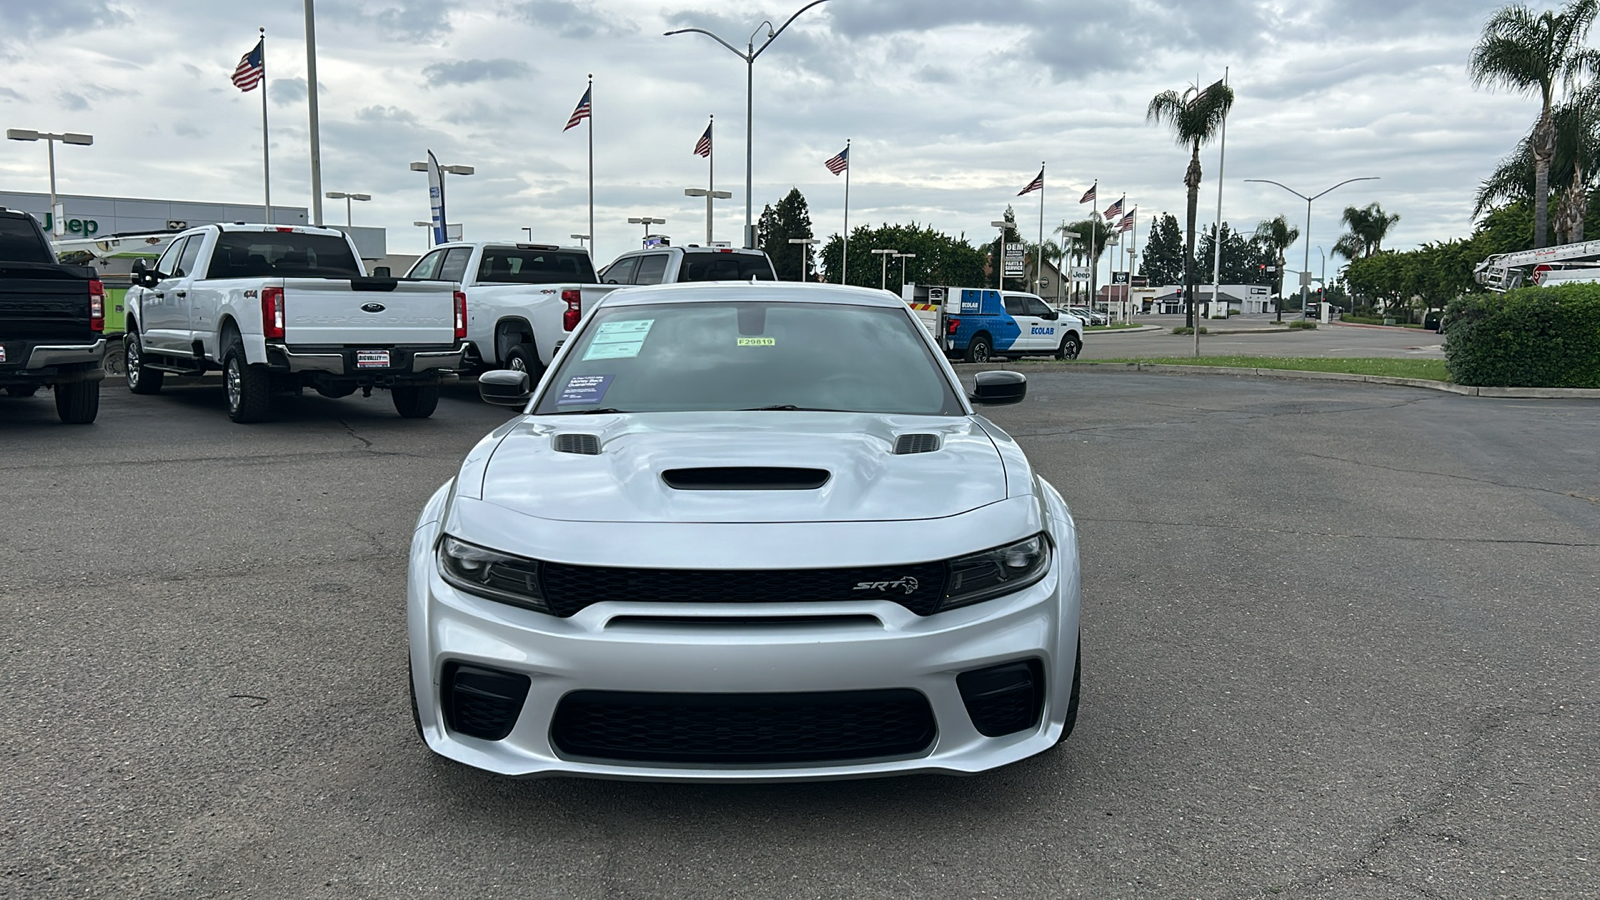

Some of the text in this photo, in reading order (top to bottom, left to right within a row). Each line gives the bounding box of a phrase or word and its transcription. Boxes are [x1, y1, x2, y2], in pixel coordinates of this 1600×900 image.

[43, 213, 98, 236] Jep
[1006, 243, 1024, 251] OEM
[295, 316, 446, 324] SUPER DUTY
[1031, 327, 1055, 336] ECOLAB
[853, 581, 906, 591] SRT
